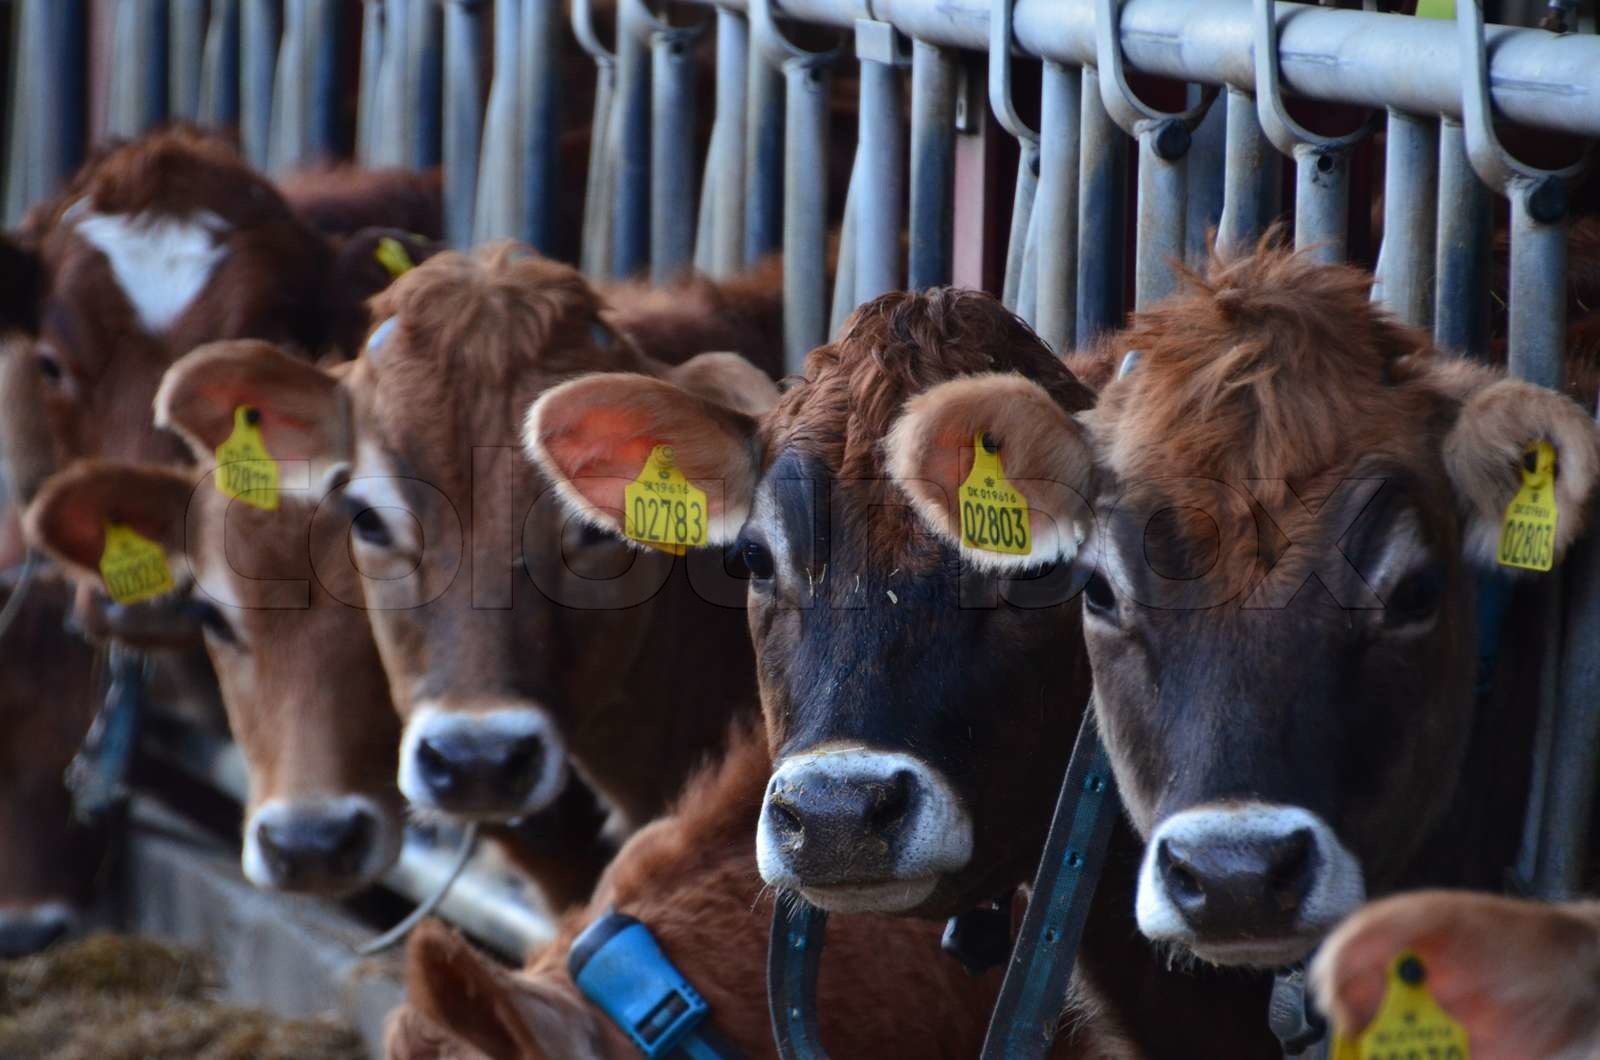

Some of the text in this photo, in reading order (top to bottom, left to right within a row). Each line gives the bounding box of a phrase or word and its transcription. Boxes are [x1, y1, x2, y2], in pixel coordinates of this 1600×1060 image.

[634, 496, 703, 543] 02783
[963, 501, 1027, 549] 02803
[1501, 519, 1552, 568] 02803
